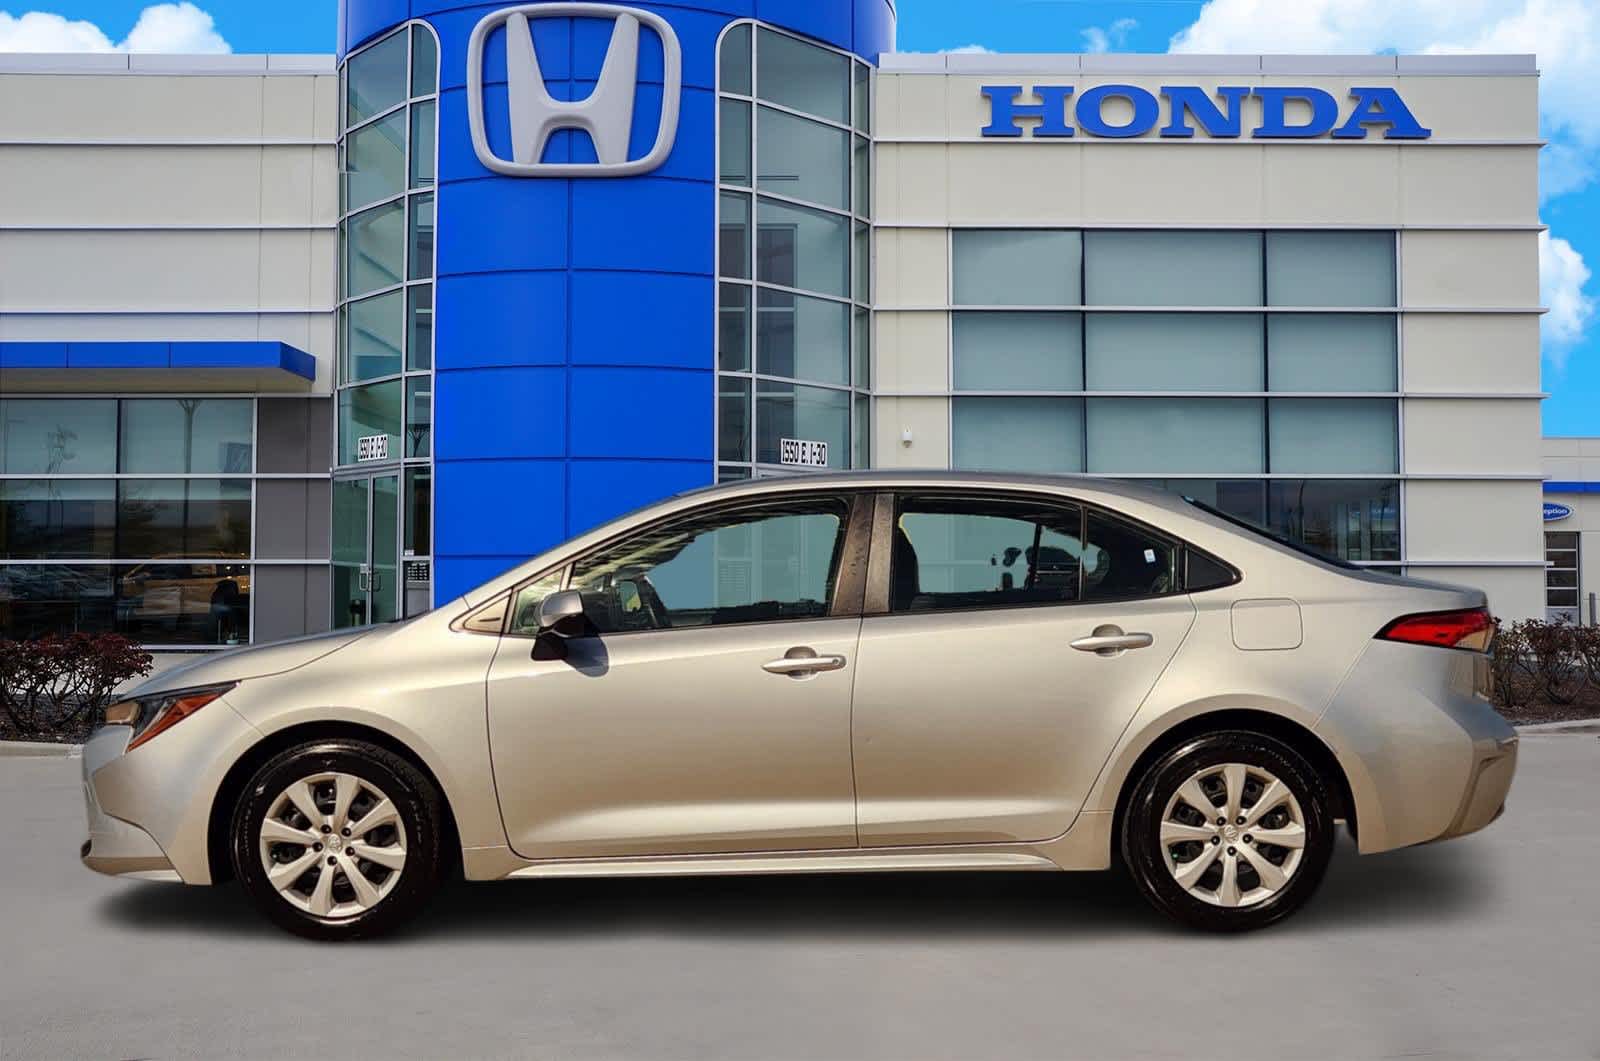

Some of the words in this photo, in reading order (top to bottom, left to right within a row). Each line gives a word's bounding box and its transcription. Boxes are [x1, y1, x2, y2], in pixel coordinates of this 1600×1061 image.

[981, 84, 1432, 139] HONDA
[782, 440, 799, 462] 1550
[810, 443, 825, 464] I-30
